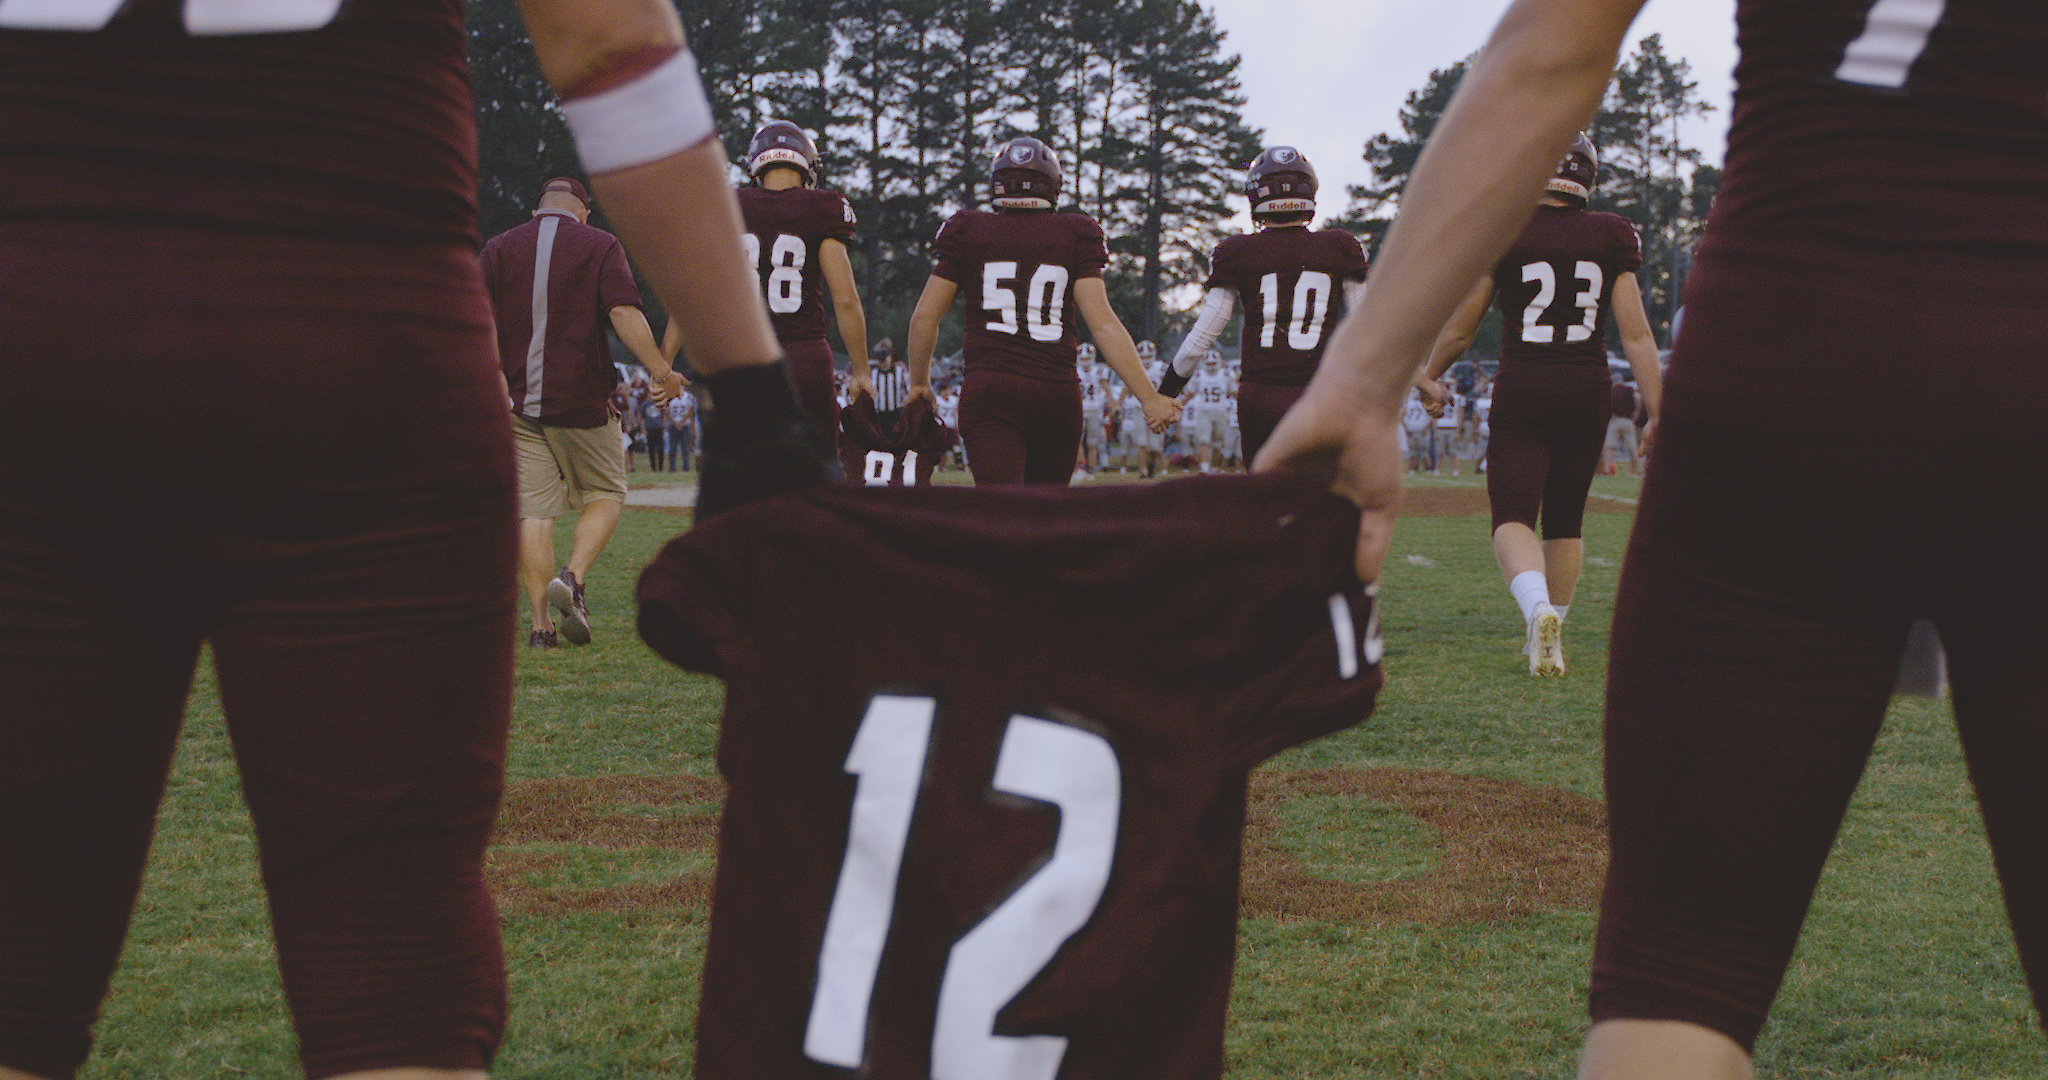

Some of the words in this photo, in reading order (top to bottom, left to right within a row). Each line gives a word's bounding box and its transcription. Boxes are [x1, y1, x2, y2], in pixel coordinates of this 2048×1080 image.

[1268, 202, 1307, 211] Riddell
[1547, 183, 1580, 193] iddell
[982, 261, 1069, 342] 50
[1259, 270, 1332, 351] 10
[1521, 260, 1603, 343] 23
[803, 695, 1122, 1080] 12
